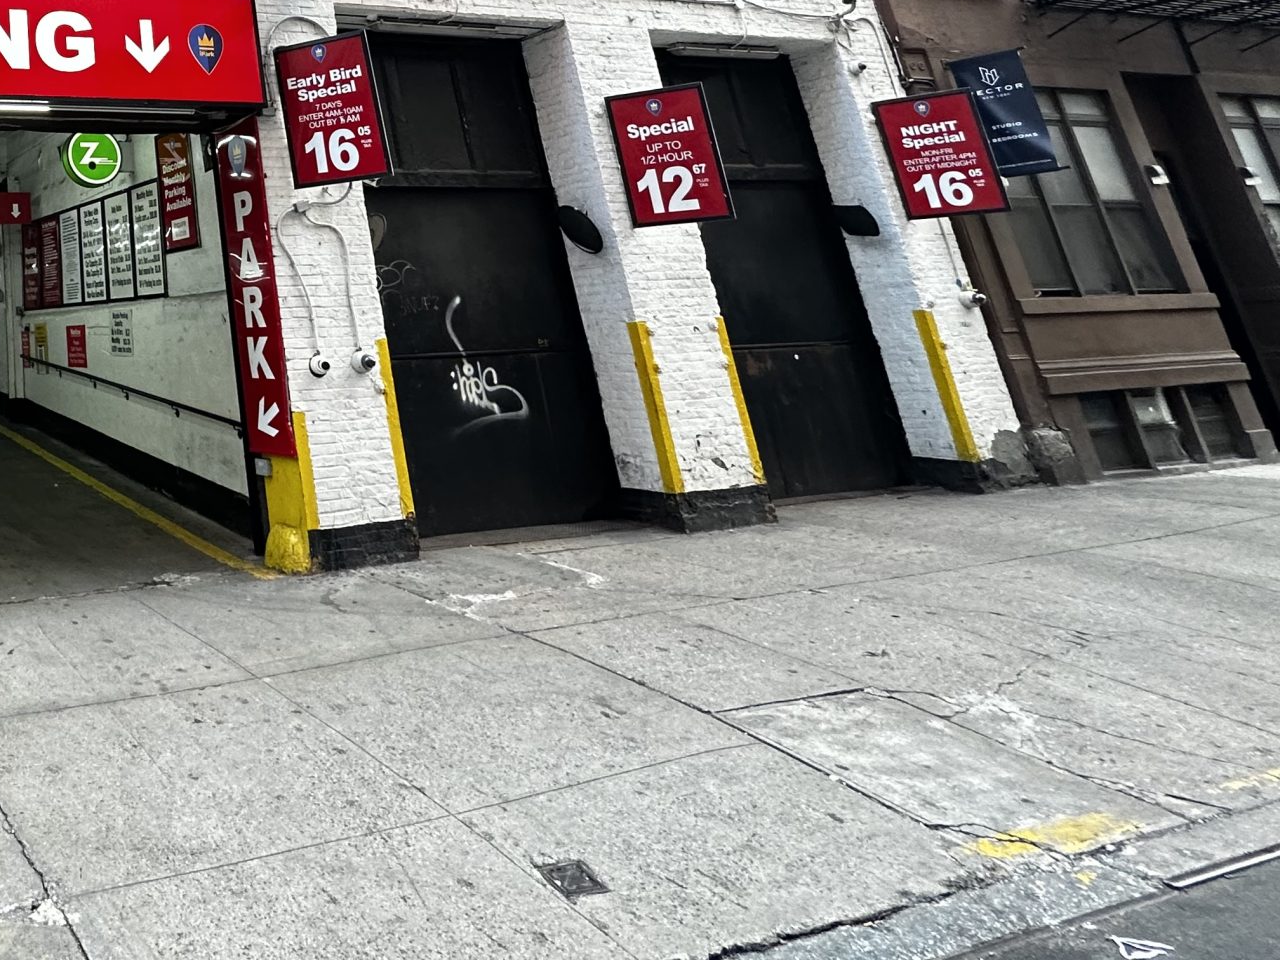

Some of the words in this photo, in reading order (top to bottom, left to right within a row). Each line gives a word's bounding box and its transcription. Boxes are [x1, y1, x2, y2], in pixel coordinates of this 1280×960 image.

[286, 73, 326, 90] Early
[329, 65, 363, 82] Bird
[297, 80, 357, 103] Special
[975, 82, 1024, 96] ECTOR
[315, 103, 320, 111] 7
[321, 100, 343, 111] DAYS
[298, 112, 324, 123] ENTER
[324, 105, 364, 118] 4AM-10AM
[309, 120, 326, 129] OUT
[326, 117, 337, 126] BY
[346, 113, 360, 123] AM
[626, 116, 695, 141] Special
[900, 120, 958, 138] NIGHT
[991, 121, 1023, 130] STUDIO
[901, 131, 966, 150] Special
[992, 132, 1039, 143] BEDROOMS
[304, 128, 360, 174] 16
[357, 126, 371, 136] 05
[646, 143, 662, 153] UP
[663, 140, 682, 150] TO
[920, 147, 953, 158] MON-FRI
[640, 155, 656, 165] 1/2
[658, 150, 694, 163] HOUR
[903, 157, 930, 167] ENTER
[931, 154, 957, 163] AFTER
[958, 151, 977, 159] 4PM
[906, 164, 924, 173] OUT
[924, 162, 936, 171] BY
[937, 158, 977, 169] MIDNIGHT
[162, 158, 187, 175] Discount
[164, 186, 186, 199] Parking
[636, 165, 701, 214] 12
[692, 163, 707, 175] 67
[912, 170, 974, 209] 16
[968, 168, 983, 178] 05
[166, 197, 192, 212] Available
[233, 190, 276, 381] PARK
